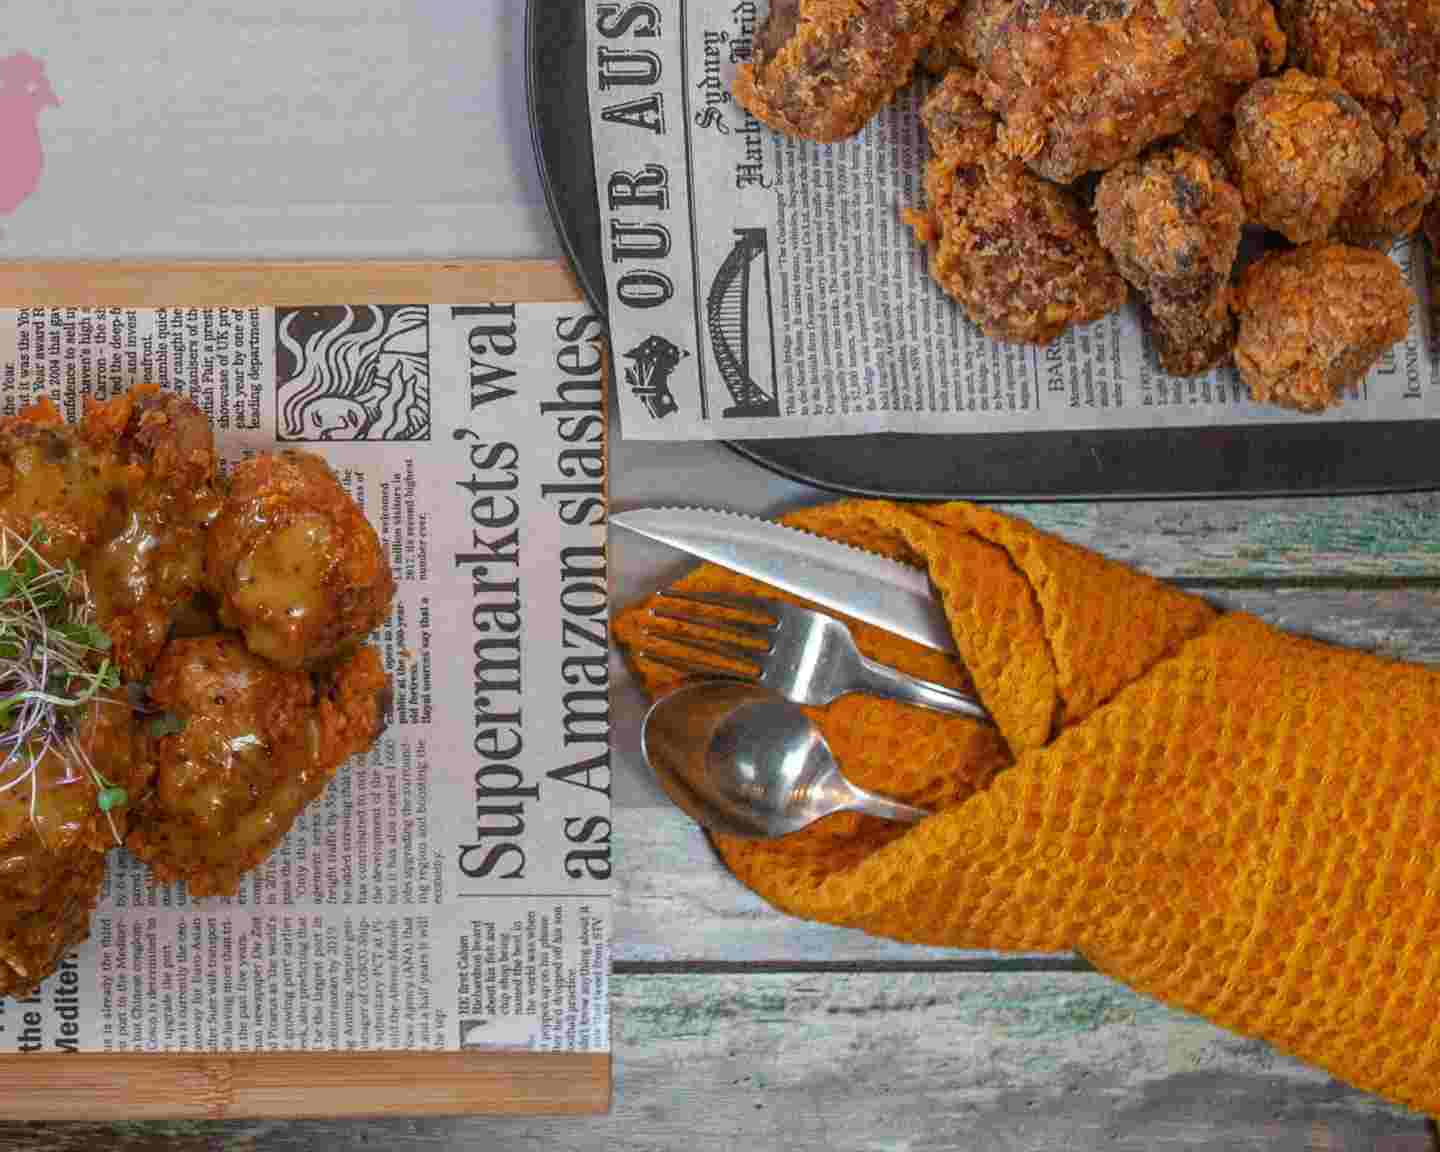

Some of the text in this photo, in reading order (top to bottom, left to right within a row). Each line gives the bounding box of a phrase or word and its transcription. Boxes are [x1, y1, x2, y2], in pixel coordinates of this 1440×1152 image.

[694, 29, 731, 136] Sydney
[735, 109, 773, 189] Harb
[608, 162, 673, 310] OUR
[18, 330, 30, 352] the
[48, 330, 60, 356] that
[79, 316, 94, 346] high
[235, 326, 244, 348] one
[20, 354, 30, 378] was
[33, 322, 45, 390] Year award
[48, 360, 60, 386] 2004
[94, 356, 106, 402] Carron
[156, 342, 172, 388] gamble
[248, 308, 264, 430] leading department
[2, 362, 14, 416] the Year.
[217, 370, 229, 430] showcase
[235, 370, 248, 396] year
[232, 400, 244, 430] each
[540, 312, 611, 880] as Amazon slashes
[452, 427, 540, 880] Supermarkets'
[53, 956, 78, 1053] editer
[18, 1011, 42, 1052] the
